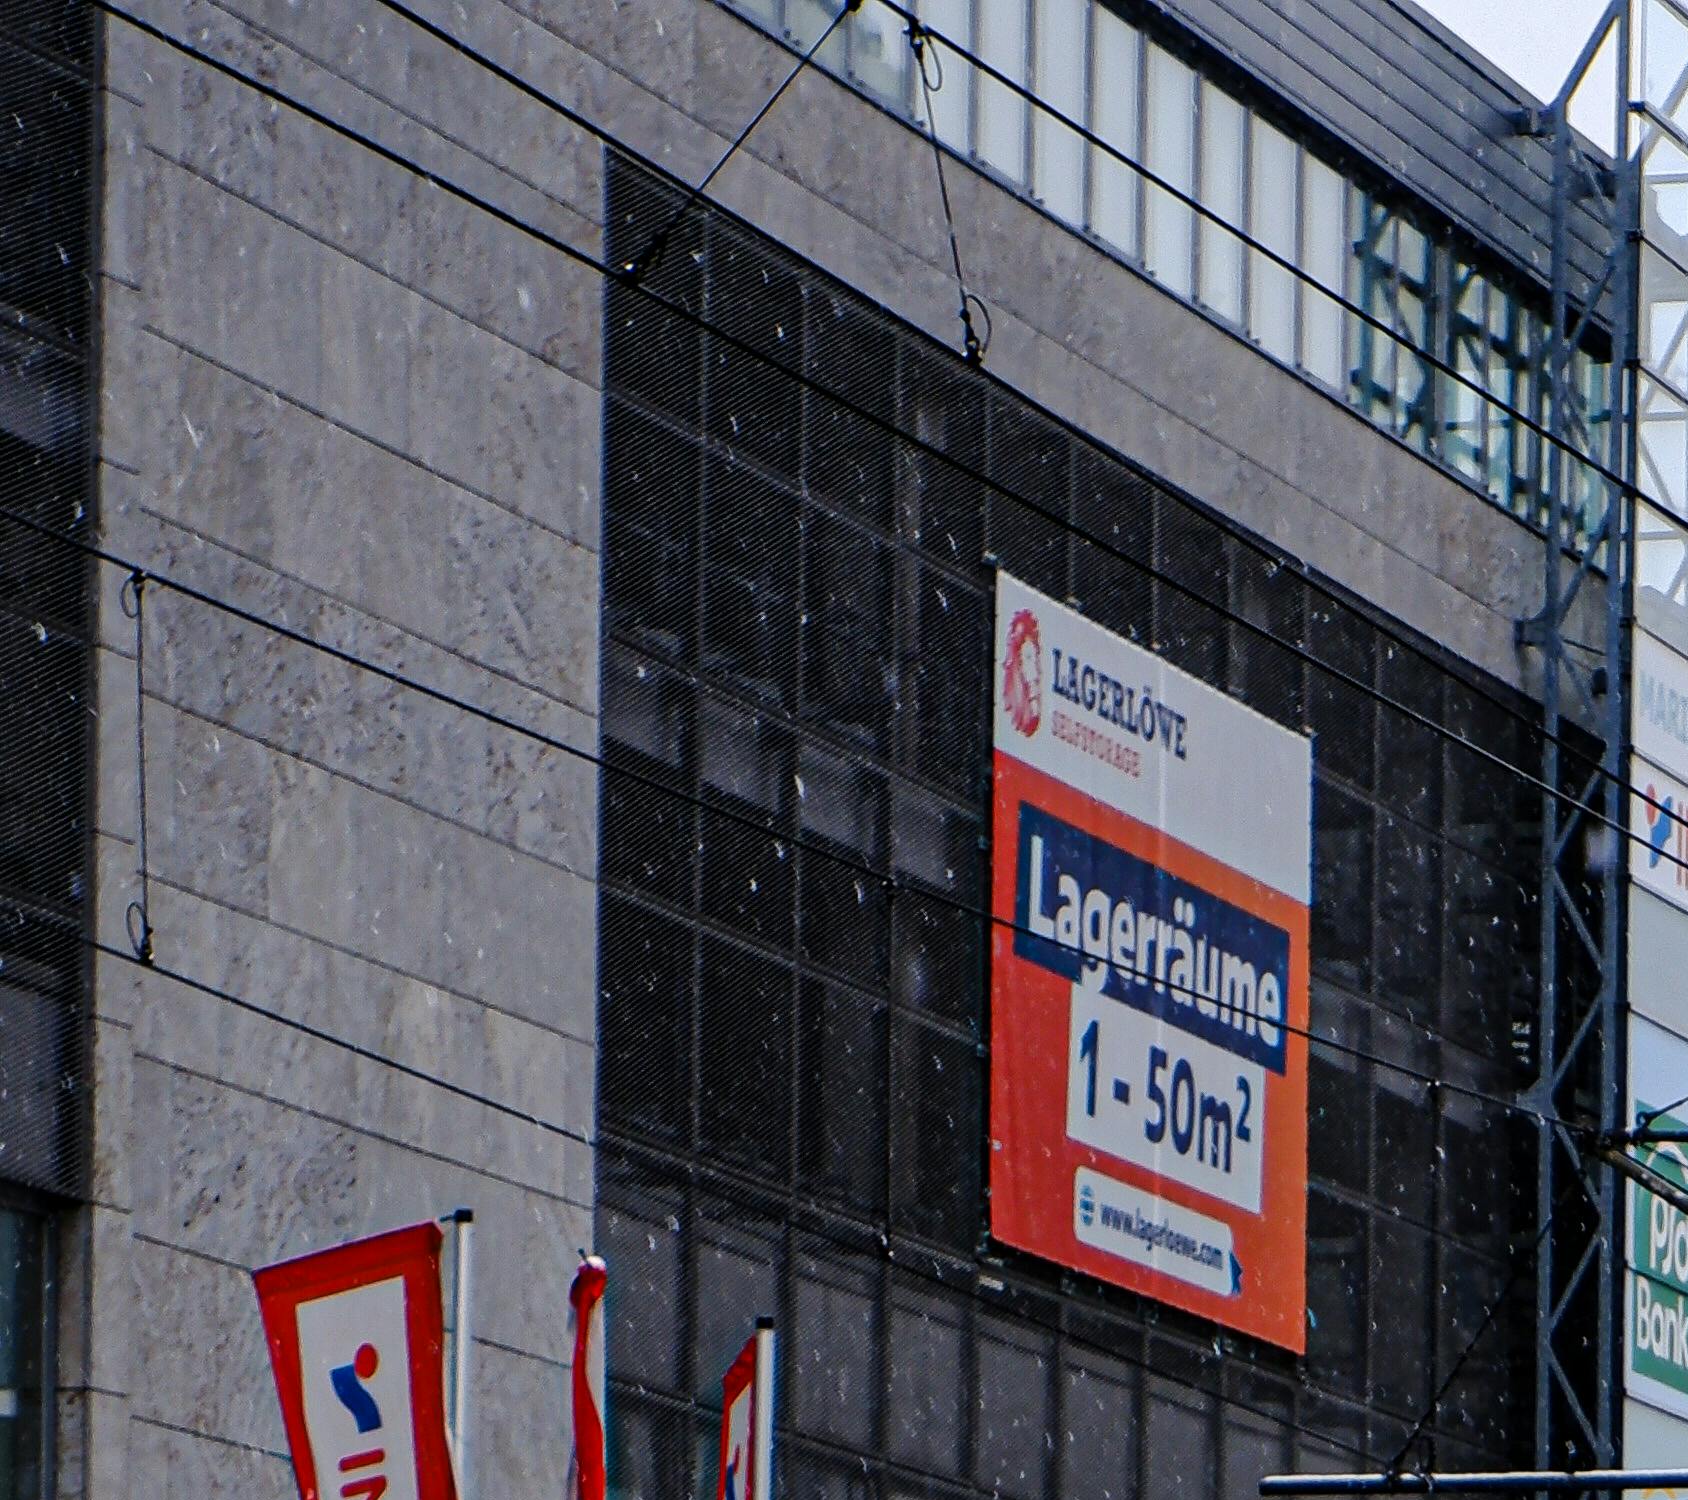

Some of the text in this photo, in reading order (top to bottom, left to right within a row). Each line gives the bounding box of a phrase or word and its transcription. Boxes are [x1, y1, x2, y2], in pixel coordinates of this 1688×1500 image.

[1052, 648, 1187, 761] LAGERLÖWE
[1029, 834, 1281, 1047] Lagerräume
[1079, 1020, 1099, 1117] 1
